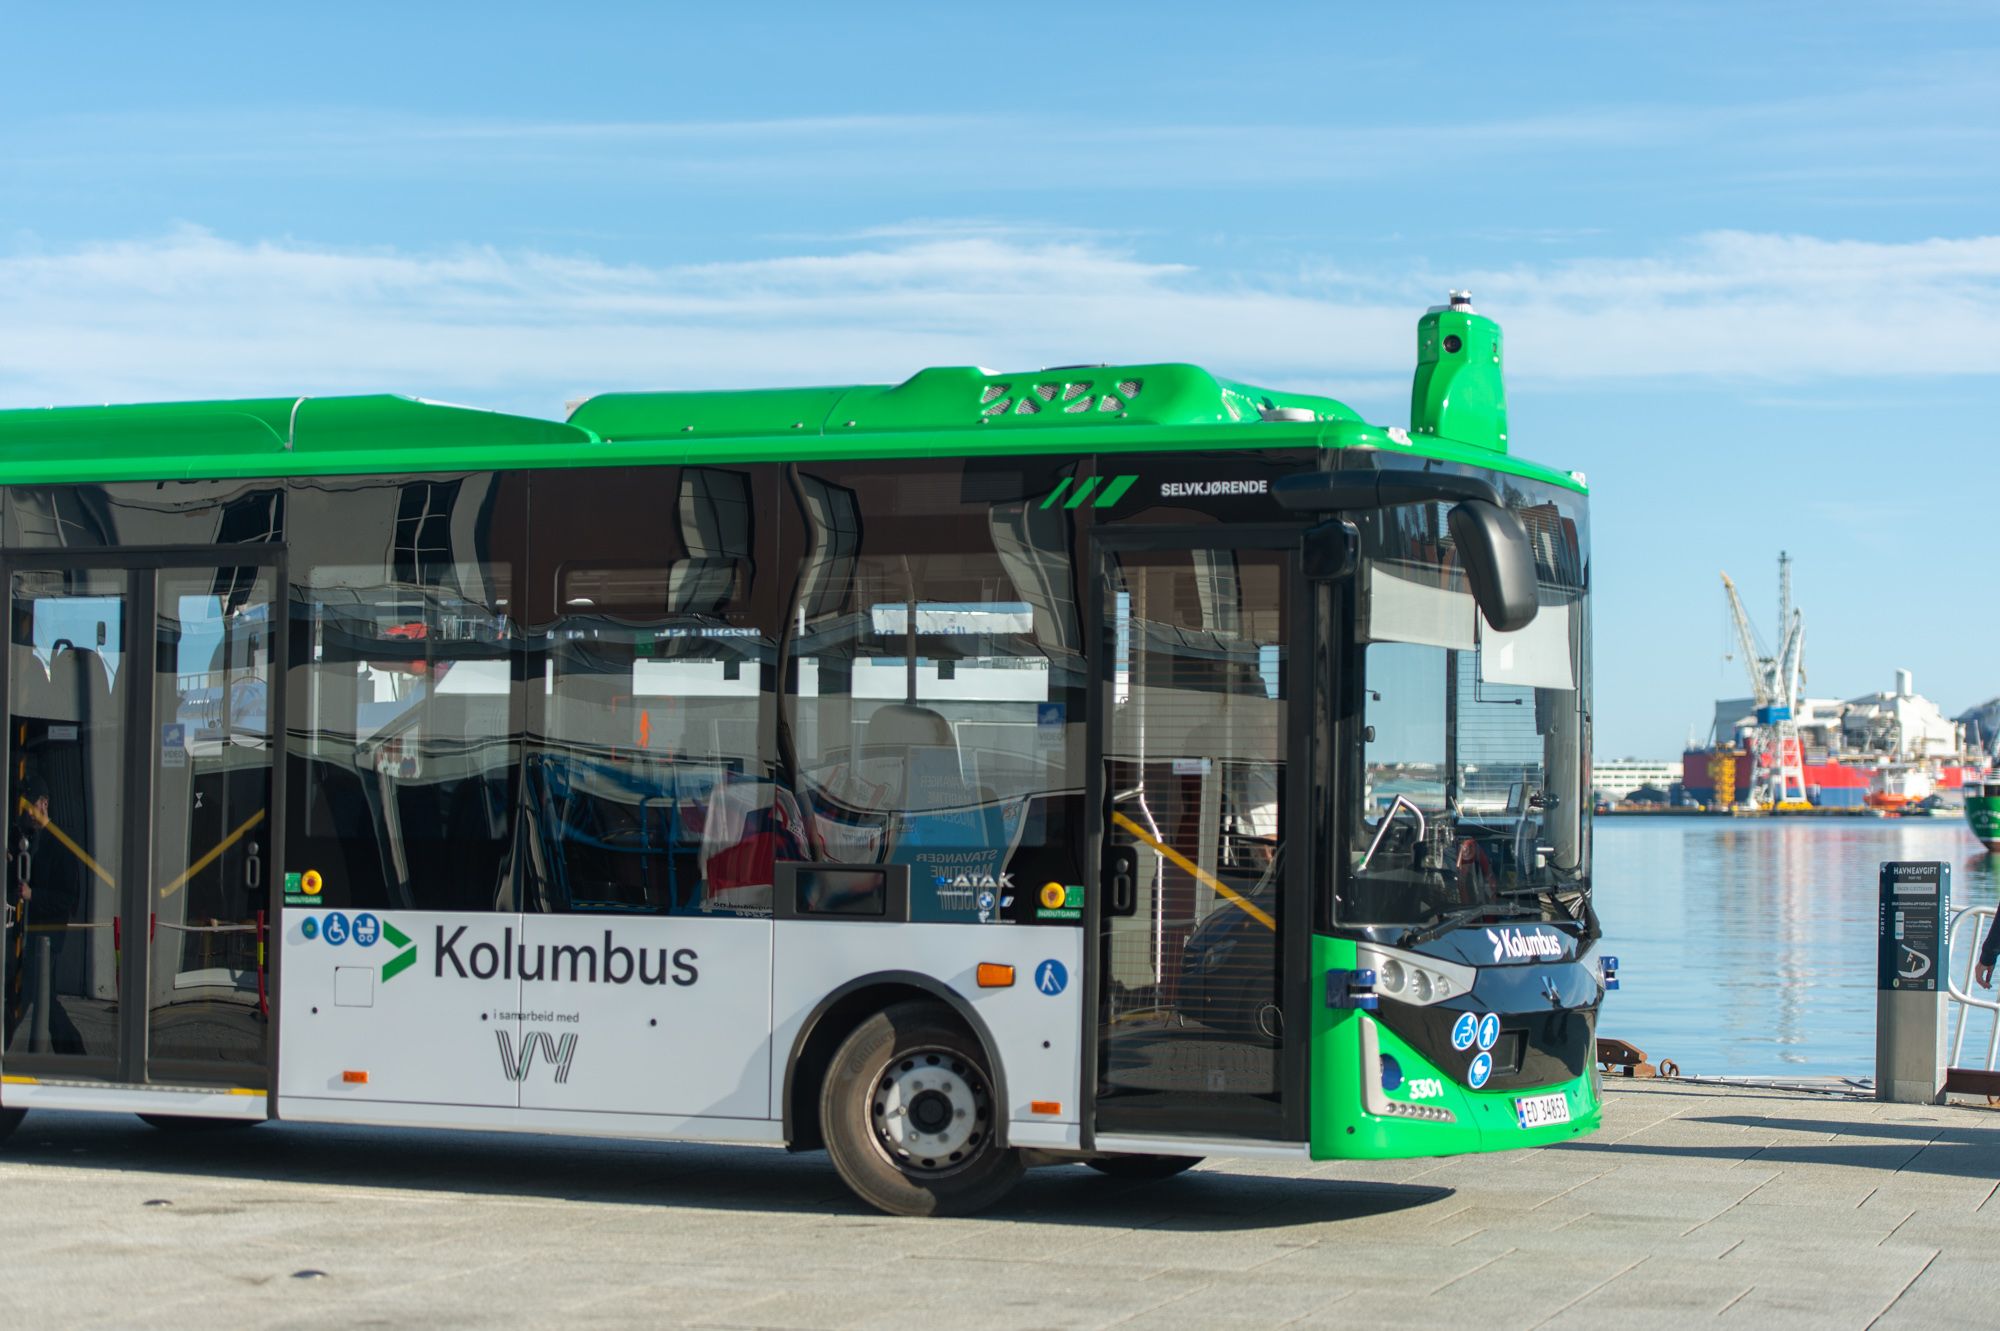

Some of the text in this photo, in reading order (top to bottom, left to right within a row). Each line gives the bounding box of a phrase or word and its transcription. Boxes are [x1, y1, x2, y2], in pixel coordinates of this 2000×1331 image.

[1161, 480, 1267, 497] SELVKJØRENDE
[1893, 866, 1937, 875] HAVNEAVGIFT
[1499, 927, 1562, 957] Kolumbus
[434, 924, 699, 987] Kolumbus
[493, 1009, 580, 1023] i samarbeid med
[1408, 1078, 1444, 1100] 3301
[1525, 1097, 1567, 1123] ED 34853
